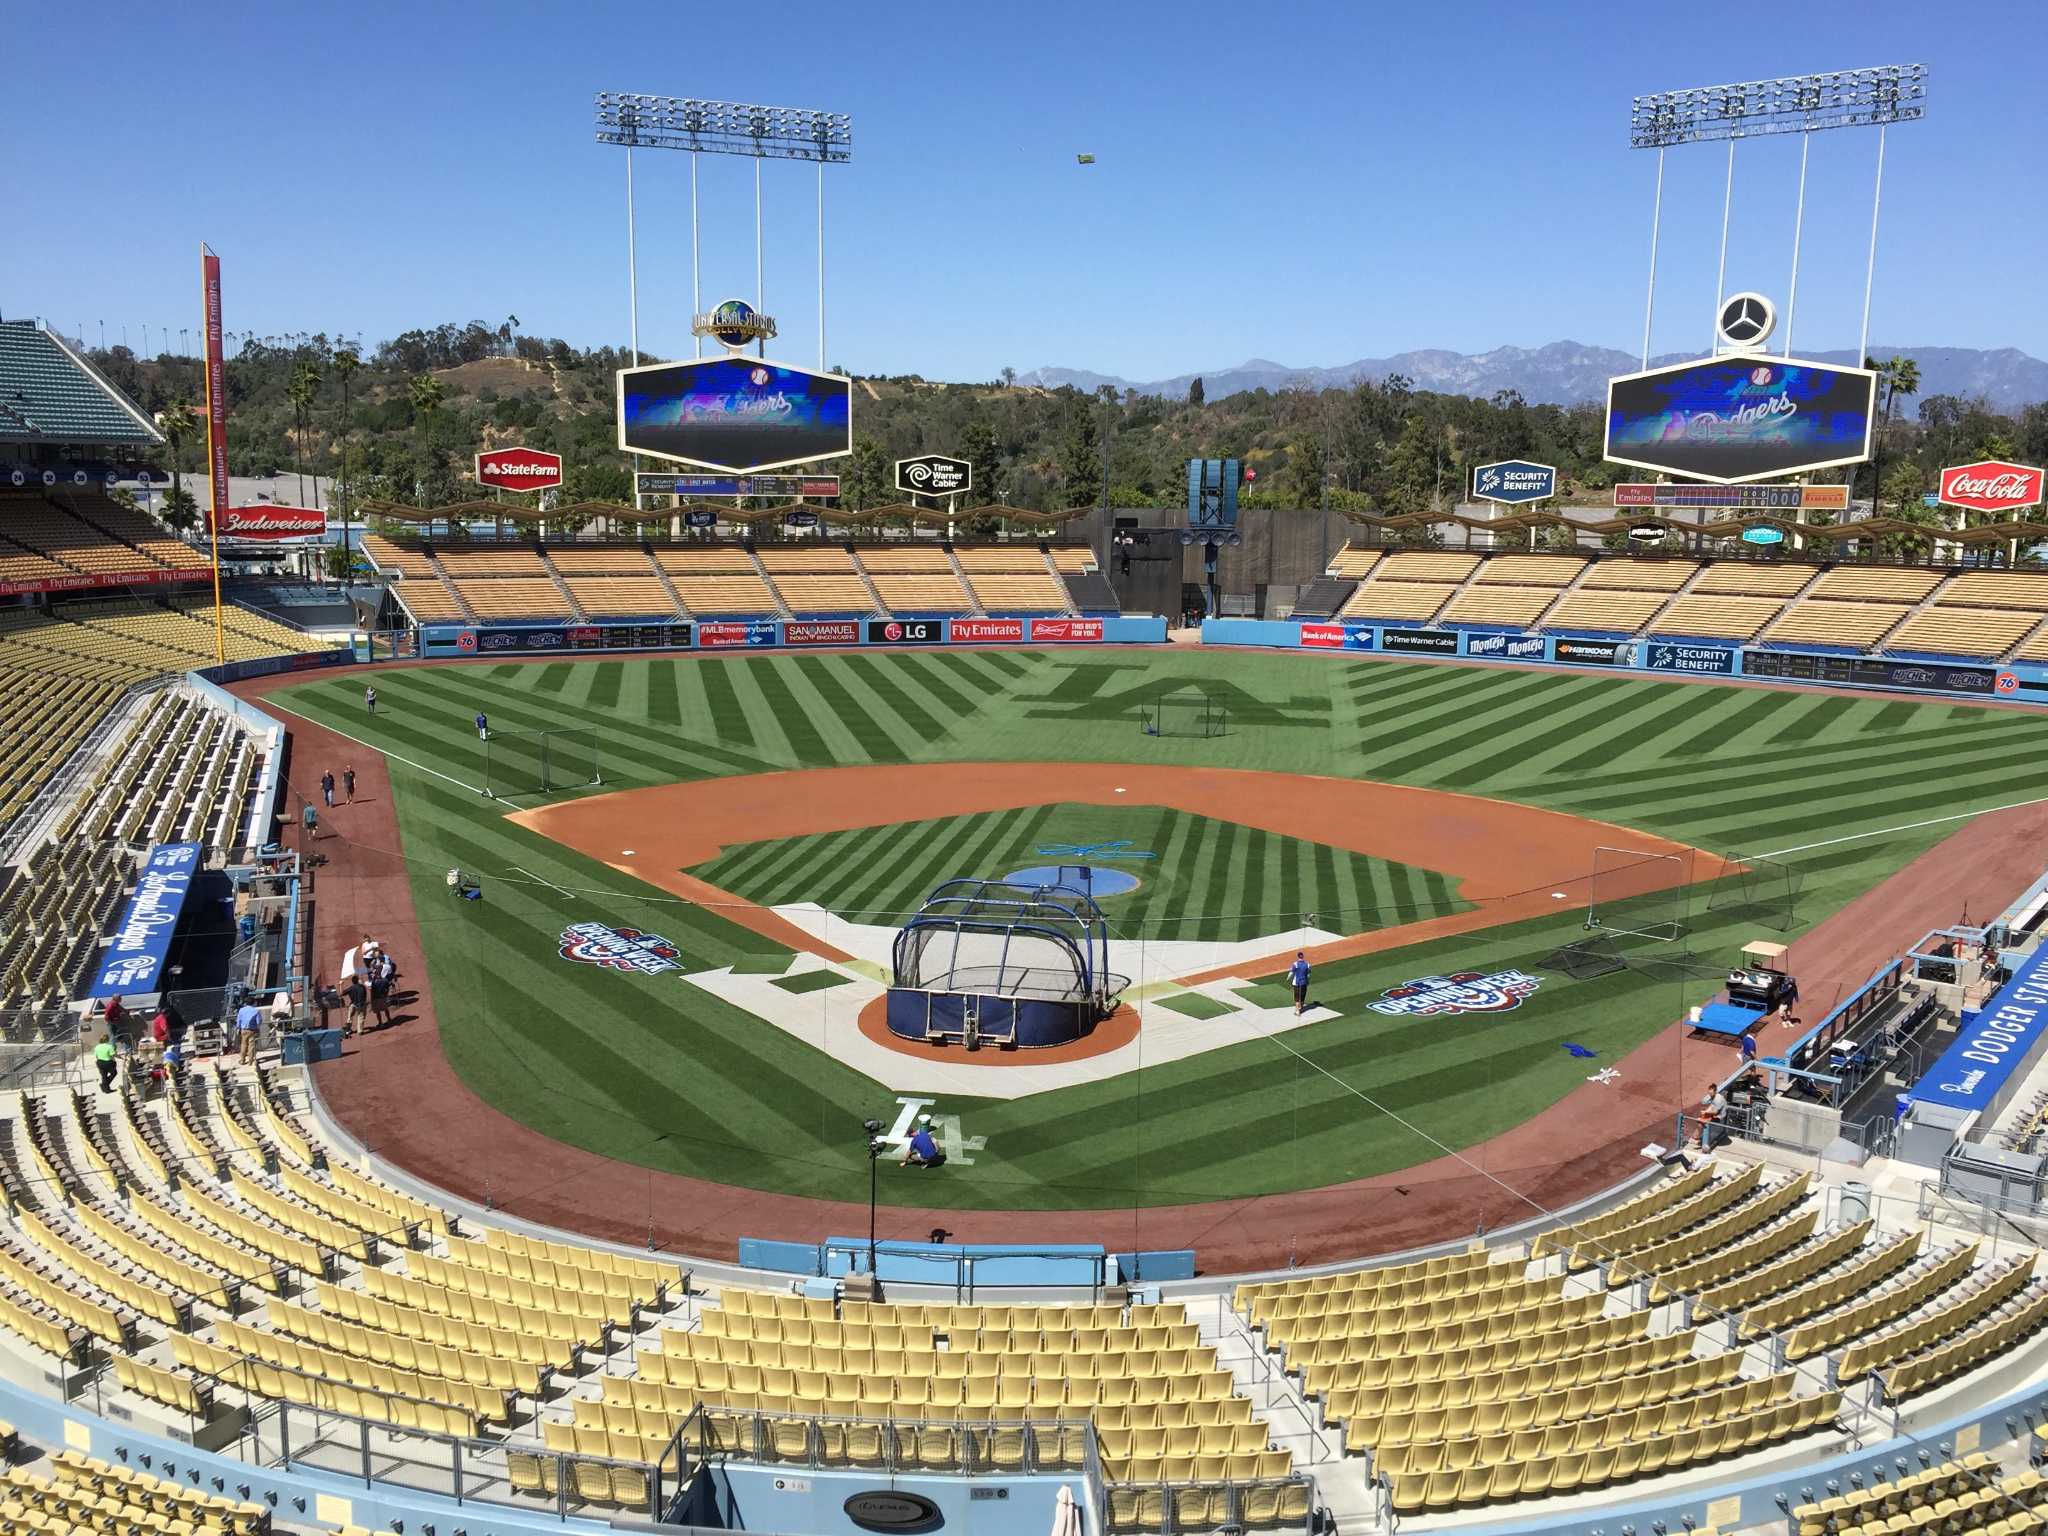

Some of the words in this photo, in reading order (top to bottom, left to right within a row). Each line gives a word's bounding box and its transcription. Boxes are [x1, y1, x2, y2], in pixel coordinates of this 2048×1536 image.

[695, 311, 743, 328] UNIVERSAL
[745, 311, 777, 331] STUDIOS
[933, 463, 954, 472] Time
[933, 471, 963, 480] Warner
[1504, 471, 1549, 481] SECURITY
[933, 479, 957, 488] Cable
[1948, 473, 2034, 500] Coca-Cola
[1618, 494, 1652, 502] Emirates
[1770, 493, 1778, 506] 0
[1781, 493, 1788, 506] 0
[1792, 493, 1800, 506] 0
[218, 513, 324, 532] Budweiser
[50, 578, 63, 589] Fly
[63, 576, 96, 587] Emirates
[103, 574, 116, 585] Fly
[116, 573, 151, 584] Emirates
[159, 571, 172, 582] Fly
[172, 569, 208, 580] Emirates
[1, 582, 12, 594] Fly
[13, 580, 42, 592] Emirates
[790, 626, 811, 636] SAN
[816, 625, 855, 635] MANUEL
[906, 624, 926, 639] LG
[952, 624, 970, 638] Fly
[972, 624, 1021, 636] Emirates
[1302, 632, 1320, 640] Bank
[1326, 633, 1355, 642] America
[1394, 635, 1409, 644] Time
[1410, 637, 1435, 645] Warner
[1435, 638, 1458, 647] Cable
[1470, 637, 1504, 655] Montejo
[1508, 639, 1544, 657] Montejo
[1676, 647, 1728, 661] SECURITY
[1892, 669, 1936, 683] HI-CHEW
[1947, 673, 1991, 687] HI-CHEW
[2000, 678, 2014, 689] 76
[569, 923, 641, 953] OPENING
[621, 948, 681, 974] WEEK
[1370, 984, 1479, 1014] OPENING
[1465, 970, 1543, 992] WEEK
[1962, 1005, 2038, 1064] DODGER
